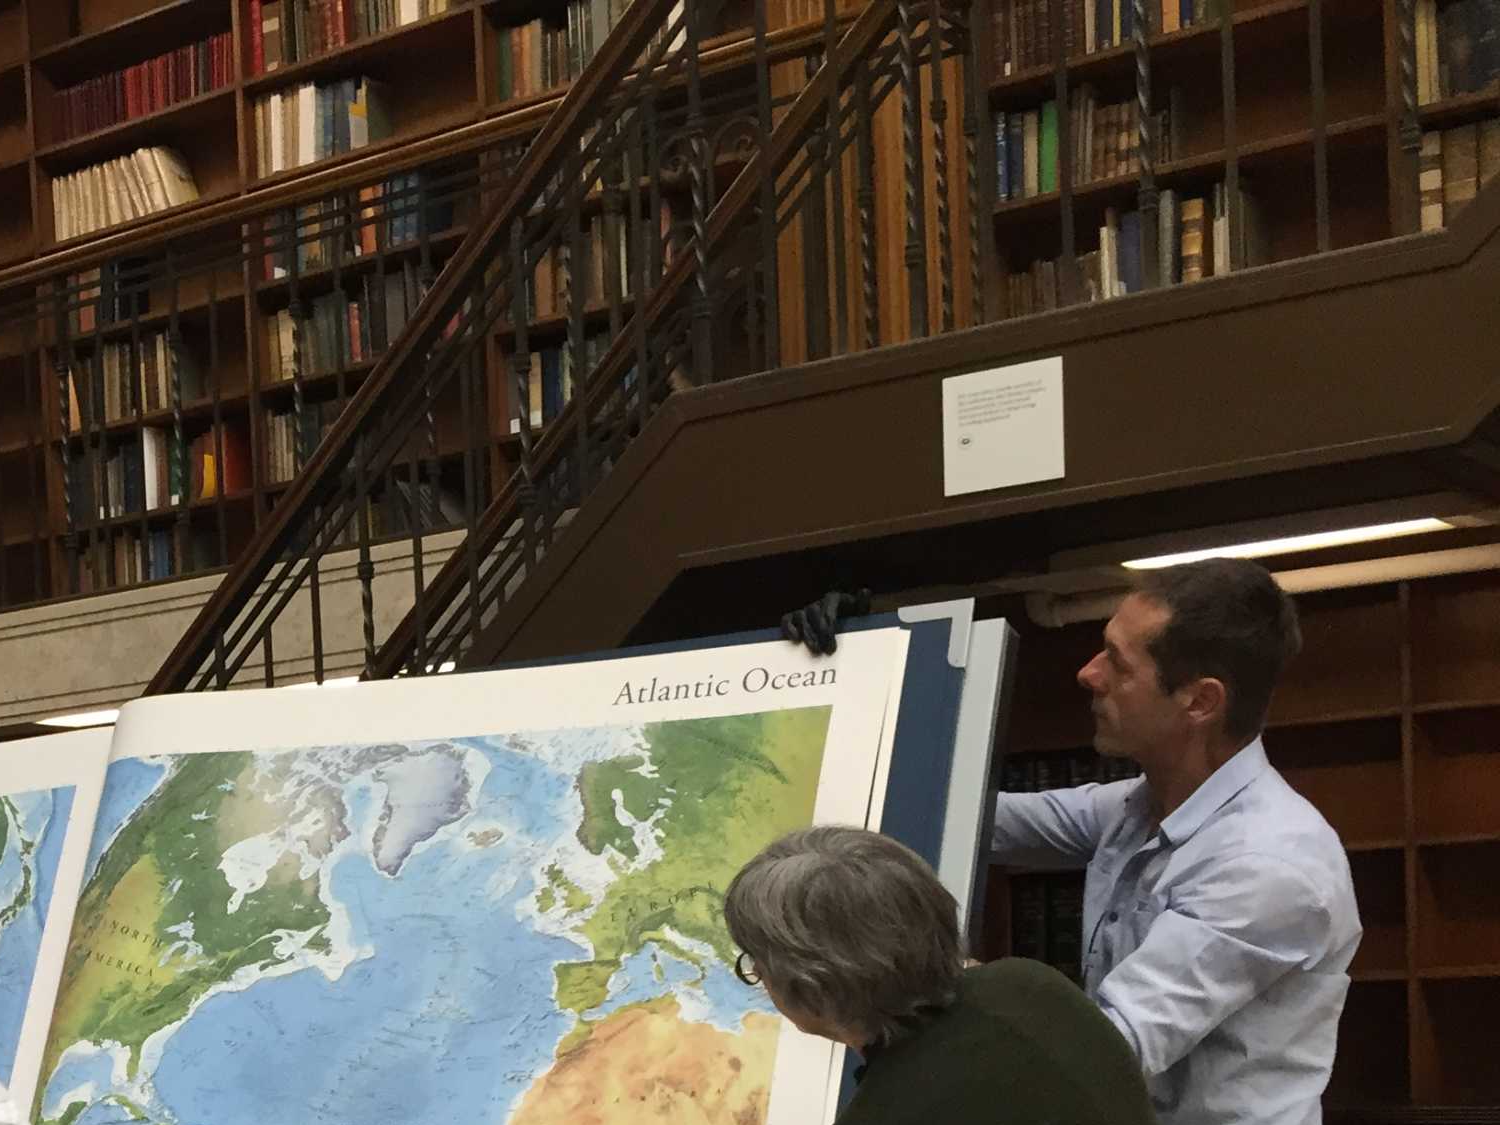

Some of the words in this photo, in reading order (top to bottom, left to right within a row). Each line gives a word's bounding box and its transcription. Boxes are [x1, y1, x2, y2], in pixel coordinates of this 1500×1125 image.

[611, 673, 731, 706] Atlantic
[741, 667, 838, 694] Ocean
[110, 919, 162, 948] NORTH
[84, 950, 154, 977] AMERICA
